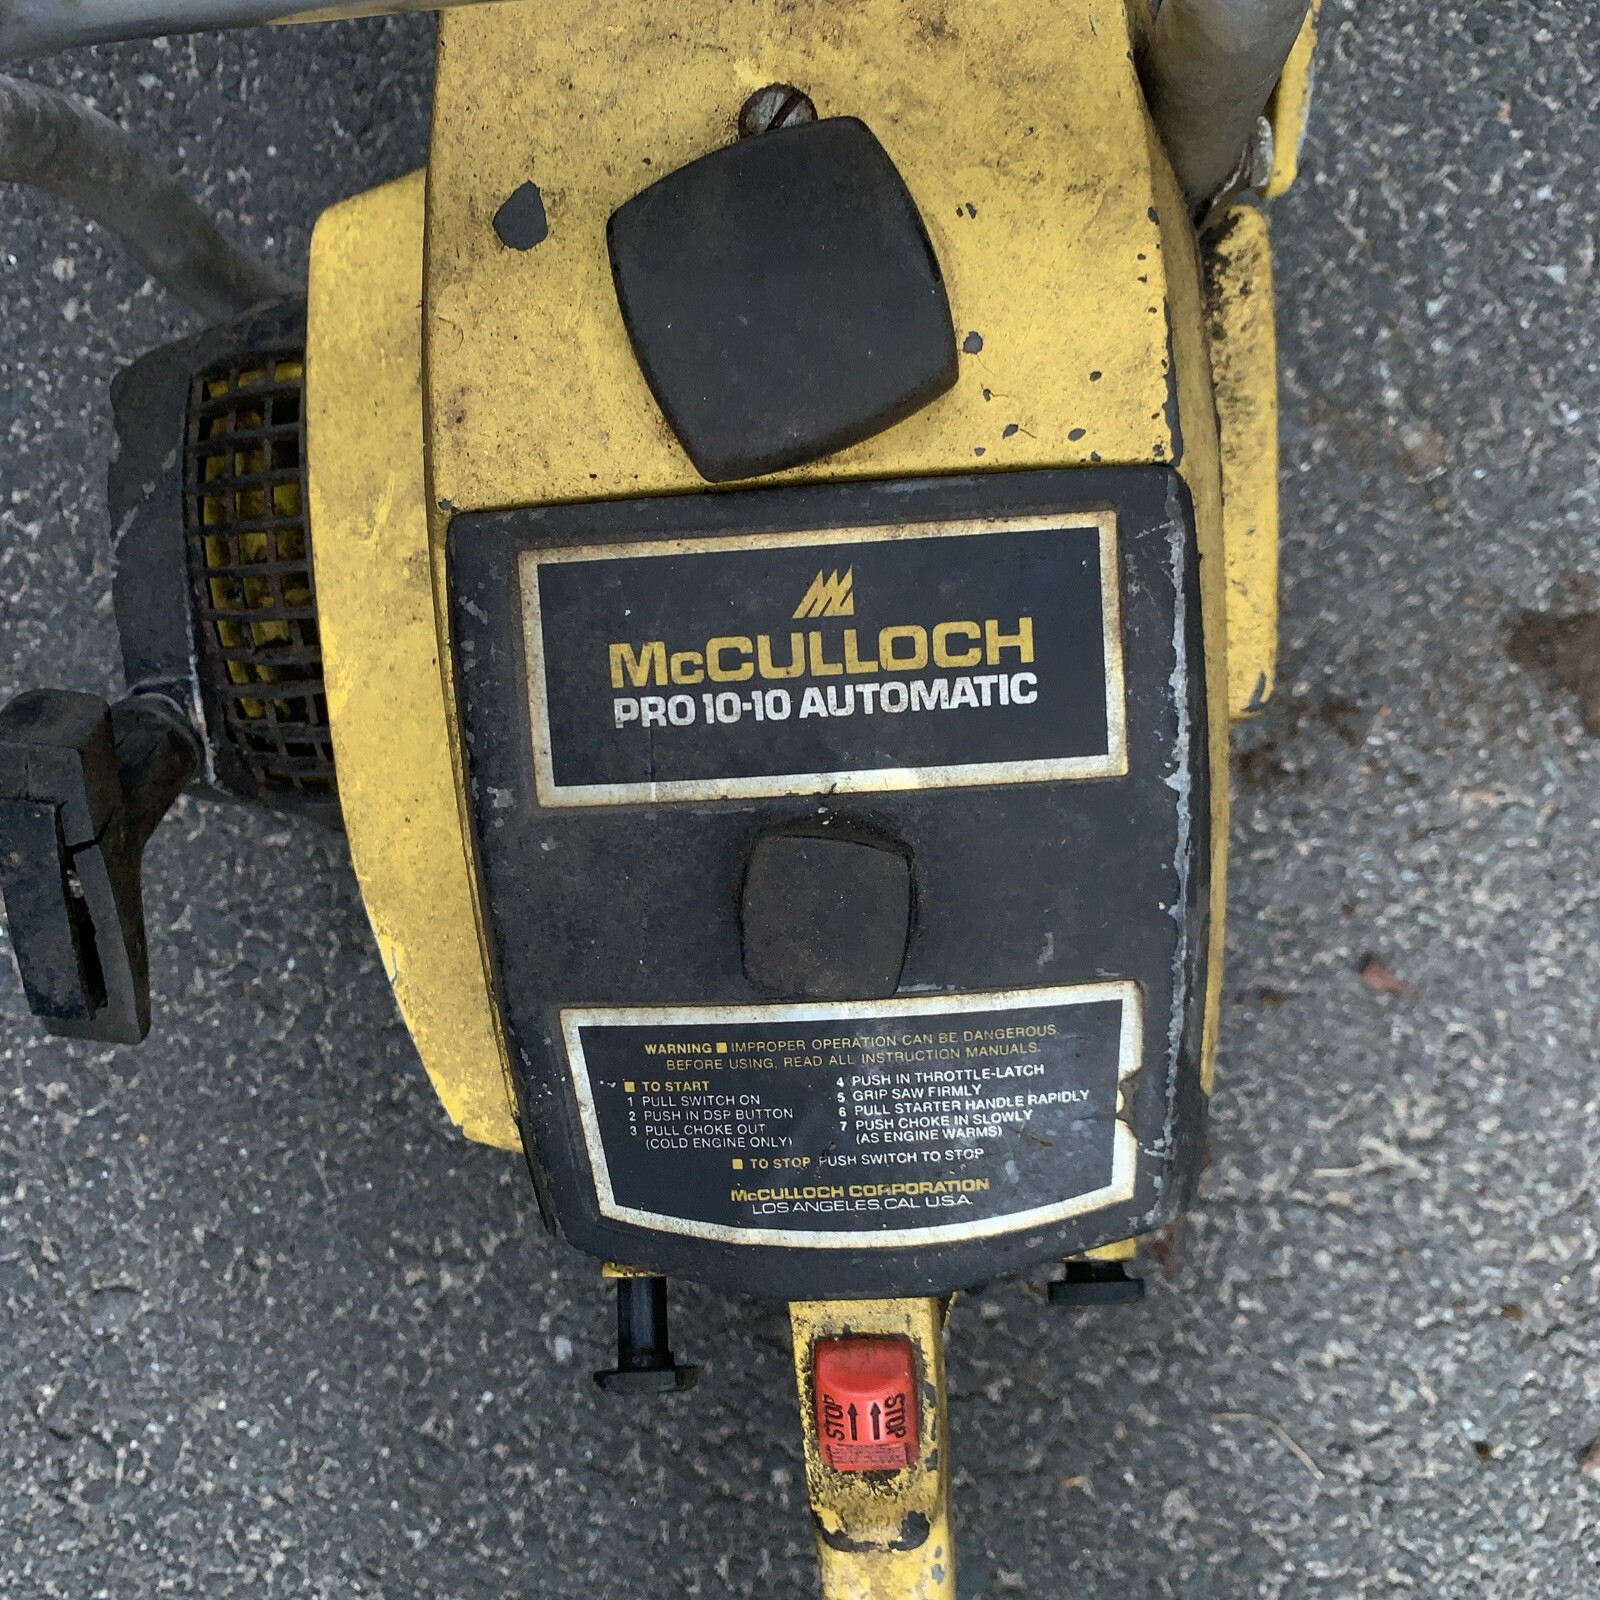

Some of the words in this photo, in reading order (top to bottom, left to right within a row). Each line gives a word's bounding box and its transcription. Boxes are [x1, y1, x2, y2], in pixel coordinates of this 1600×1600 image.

[609, 616, 1035, 688] McCULLOCH
[614, 695, 696, 729] PRO
[703, 688, 792, 724] 10-10
[799, 672, 1038, 718] AUTOMATIC
[645, 1042, 712, 1054] WARNING
[731, 1040, 806, 1053] IMPROPER
[812, 1035, 897, 1050] OPERATION
[902, 1033, 933, 1045] CAN
[938, 1032, 958, 1044] BE
[963, 1024, 1060, 1042] DANGEROUS.
[666, 1059, 723, 1070] BEFORE
[783, 1056, 823, 1068] READ
[828, 1054, 855, 1065] ALL
[861, 1049, 960, 1064] INSTRUCTION
[966, 1041, 1042, 1058] MANUALS.
[642, 1081, 661, 1092] TO
[665, 1080, 710, 1092] START
[836, 1076, 844, 1087] 4
[852, 1075, 892, 1087] PUSH
[896, 1073, 910, 1084] IN
[914, 1064, 1045, 1084] THROTTLE-LATCH
[627, 1096, 633, 1106] 1
[642, 1096, 677, 1107] PULL
[681, 1095, 735, 1106] SWITCH
[739, 1094, 761, 1105] ON
[837, 1092, 845, 1103] 5
[852, 1089, 888, 1102] GRIP
[891, 1087, 924, 1100] SAW
[929, 1084, 982, 1098] FIRMLY
[838, 1107, 847, 1117] 6
[855, 1104, 891, 1117] PULL
[894, 1100, 961, 1114] STARTER
[965, 1095, 1024, 1111] HANDLE
[1028, 1089, 1090, 1106] RAPIDLY
[629, 1112, 637, 1122] 2
[644, 1111, 681, 1122] PUSH
[686, 1111, 699, 1121] IN
[704, 1110, 731, 1121] DSP
[736, 1108, 794, 1120] BUTTON
[839, 1121, 847, 1131] 7
[855, 1118, 894, 1131] PUSH
[898, 1115, 950, 1129] CHOKE
[954, 1114, 969, 1126] IN
[972, 1109, 1033, 1125] SLOWLY
[630, 1126, 637, 1136] 3
[645, 1126, 680, 1136] PULL
[684, 1125, 732, 1136] CHOKE
[737, 1124, 766, 1135] OUT
[855, 1132, 880, 1145] (AS
[884, 1129, 939, 1143] ENGINE
[942, 1125, 1003, 1140] WARMS)
[646, 1138, 688, 1150] (COLD
[693, 1138, 746, 1148] ENGINE
[750, 1137, 793, 1148] ONLY)
[750, 1158, 769, 1169] TO
[773, 1156, 811, 1168] STOP
[819, 1155, 857, 1167] PUSH
[861, 1151, 917, 1166] SWITCH
[921, 1150, 941, 1163] TO
[944, 1148, 985, 1161] STOP
[731, 1185, 844, 1202] McCULLOCH
[848, 1178, 990, 1198] CORPORATION
[752, 1202, 790, 1215] LOS
[823, 1394, 845, 1441] STOP
[885, 1393, 906, 1438] STOP
